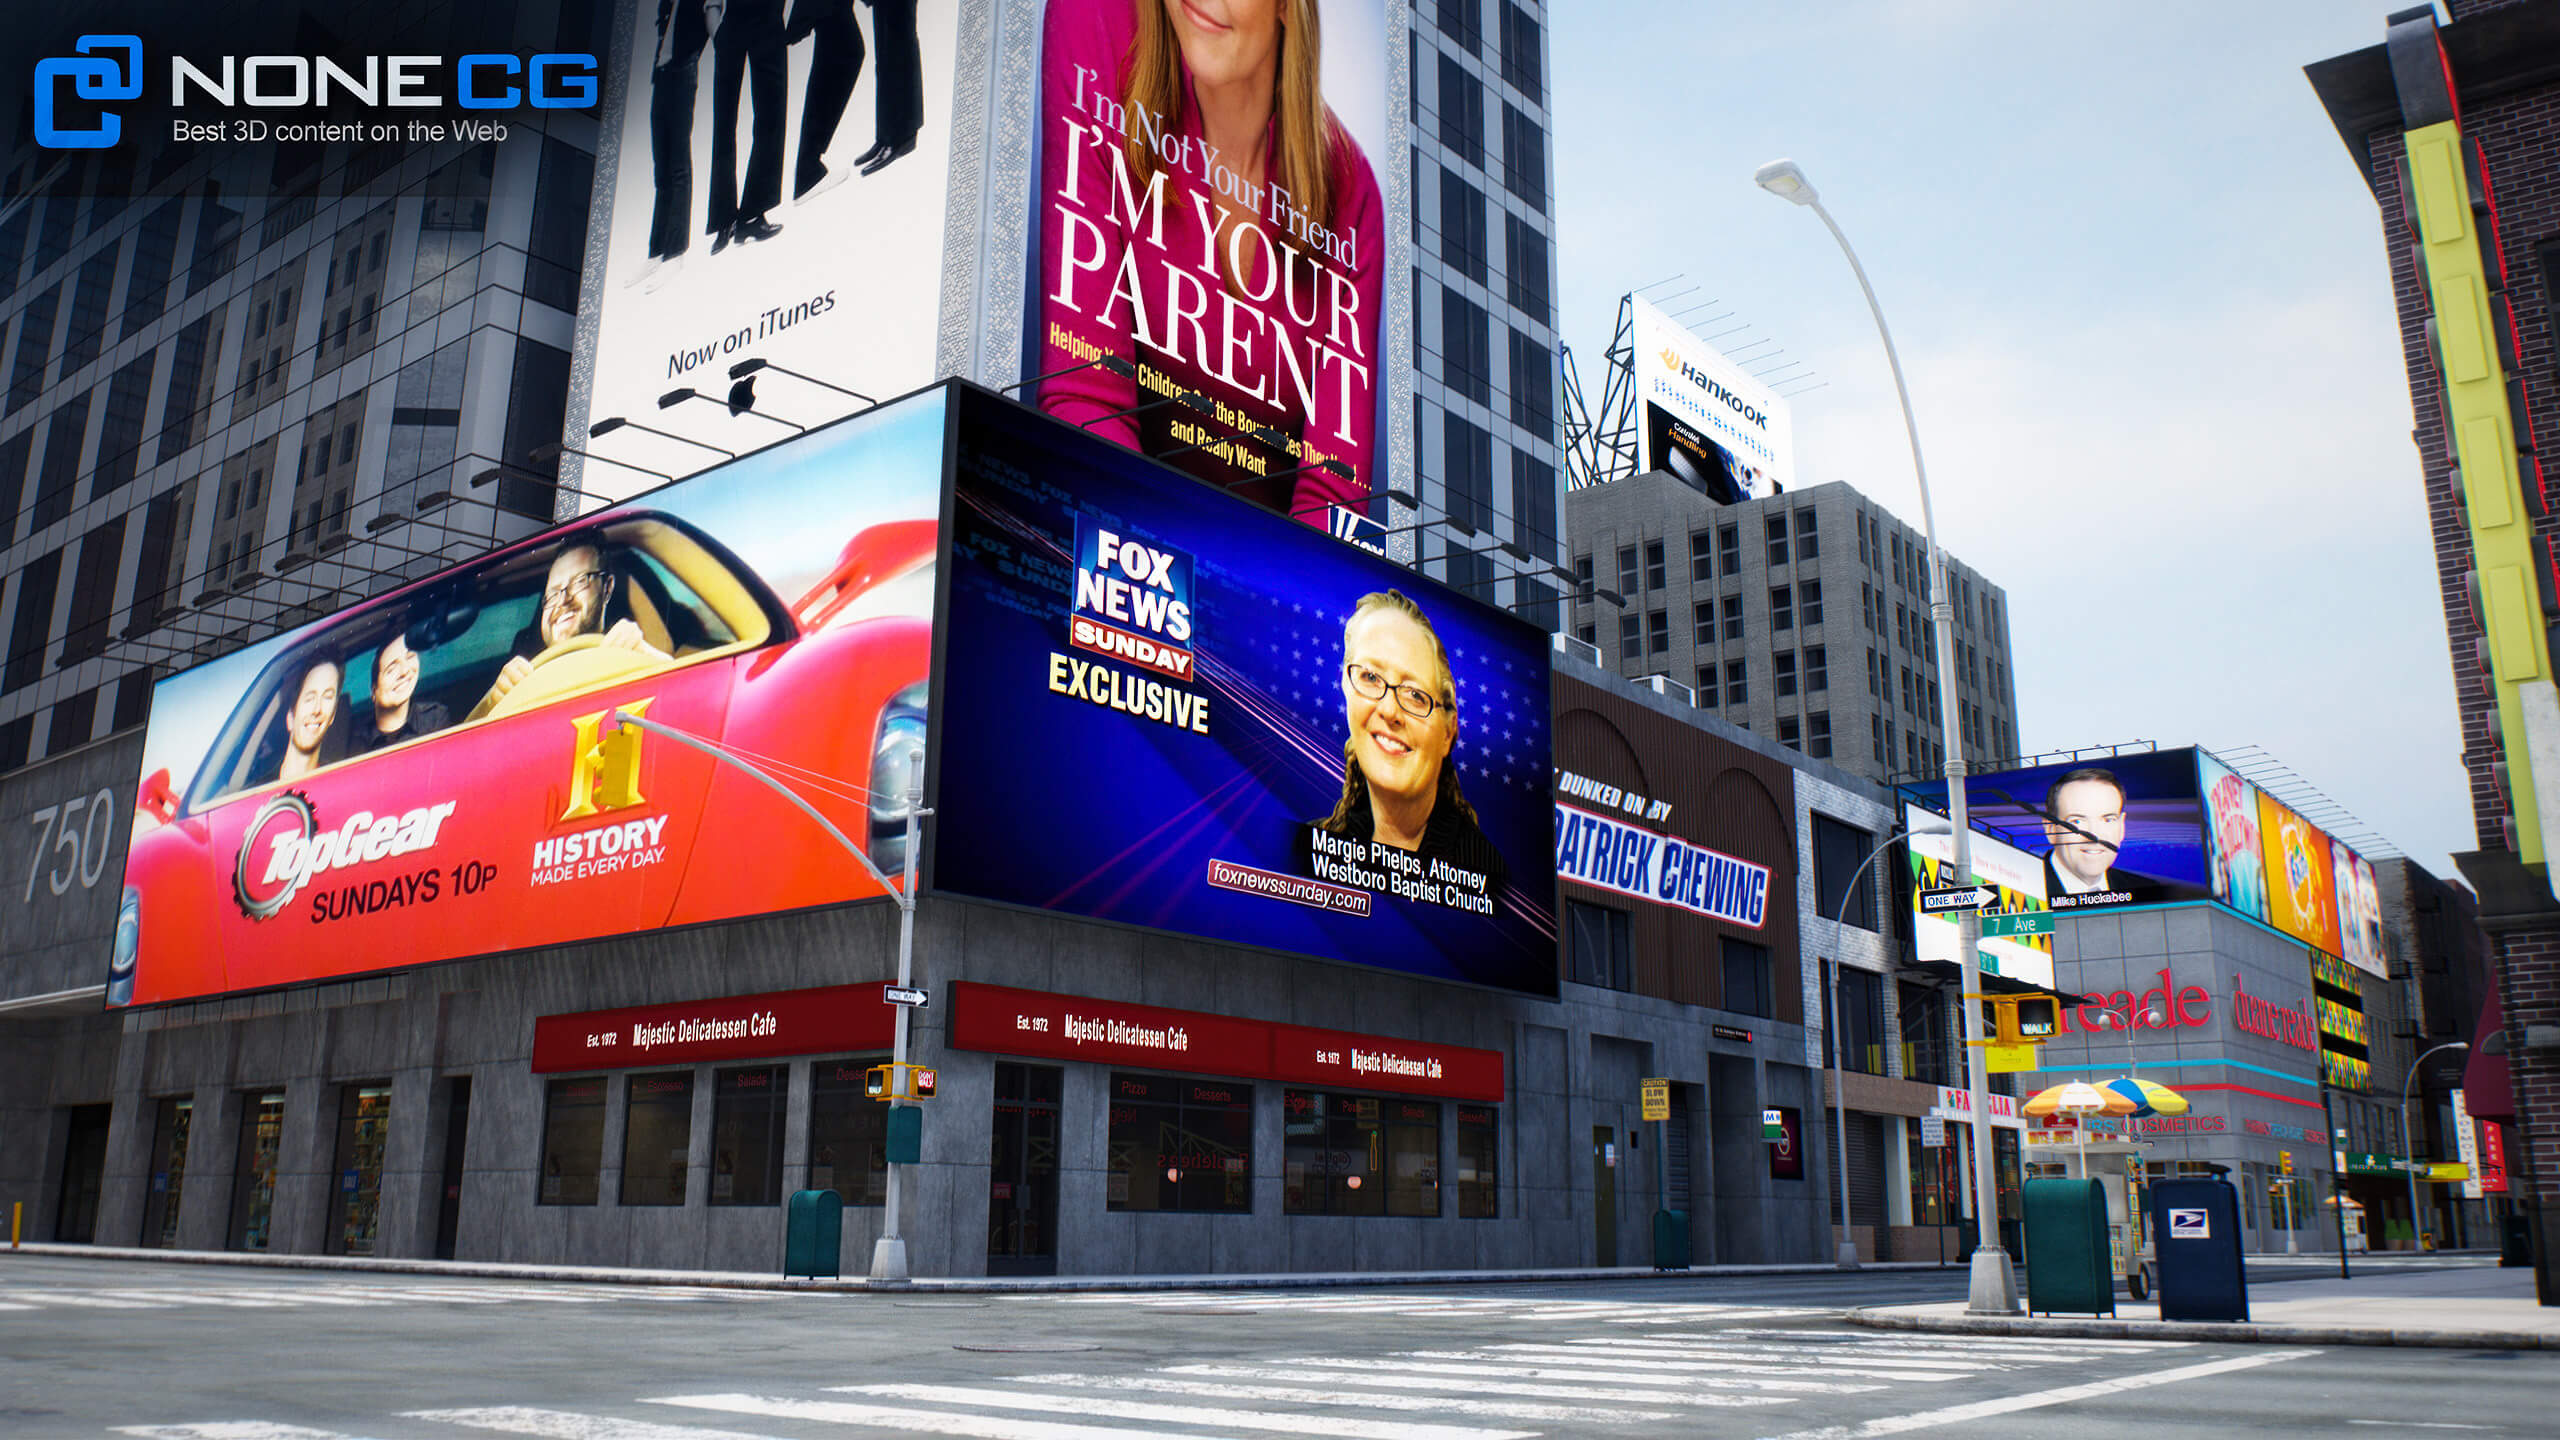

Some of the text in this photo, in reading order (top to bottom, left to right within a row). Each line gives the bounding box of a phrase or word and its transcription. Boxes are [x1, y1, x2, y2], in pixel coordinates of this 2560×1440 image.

[1072, 62, 1359, 272] I'm Not Your Friend
[1057, 115, 1365, 359] I'M YOUR
[667, 289, 836, 379] Now on iTunes
[1049, 203, 1368, 447] PARENT
[1050, 321, 1102, 370] Helping
[1216, 401, 1235, 427] the
[1171, 419, 1267, 477] and Really Want
[1097, 528, 1175, 593] FOX
[1076, 567, 1191, 641] NEWS
[1075, 620, 1190, 674] SUNDAY
[1049, 652, 1209, 734] EXCLUSIVE
[1558, 770, 1672, 822] DUNKED ON BY
[24, 787, 114, 904] 750
[530, 862, 574, 887] MADE
[577, 853, 629, 879] EVERY
[532, 814, 669, 870] HISTORY
[1312, 827, 1487, 895] Margie Phelps, Attorney
[310, 867, 440, 924] SUNDAYS
[1213, 862, 1368, 912] foxnewssunday.com
[1312, 853, 1494, 916] Westboro Baptist Church
[1658, 841, 1767, 924] CHEWING
[1927, 893, 1976, 907] ONE WAY
[2051, 891, 2133, 907] Mike Huckabee
[1992, 916, 2037, 935] 7 Ave
[601, 1031, 617, 1047] 1972
[632, 1021, 676, 1051] Majestic
[678, 1017, 747, 1043] Delicatessen
[750, 1011, 776, 1037] Cafe
[1032, 1017, 1048, 1032] 1972
[1064, 1013, 1105, 1045] Majestic
[1107, 1018, 1165, 1049] Delicatessen
[1167, 1026, 1188, 1051] Cafe
[2021, 1023, 2053, 1035] WALK
[1351, 1048, 1381, 1076] Majestic
[1382, 1053, 1425, 1077] Delicatessen
[1426, 1057, 1442, 1079] Cafe
[1645, 1088, 1664, 1097] SLOW
[2122, 1116, 2226, 1133] COSMETICS
